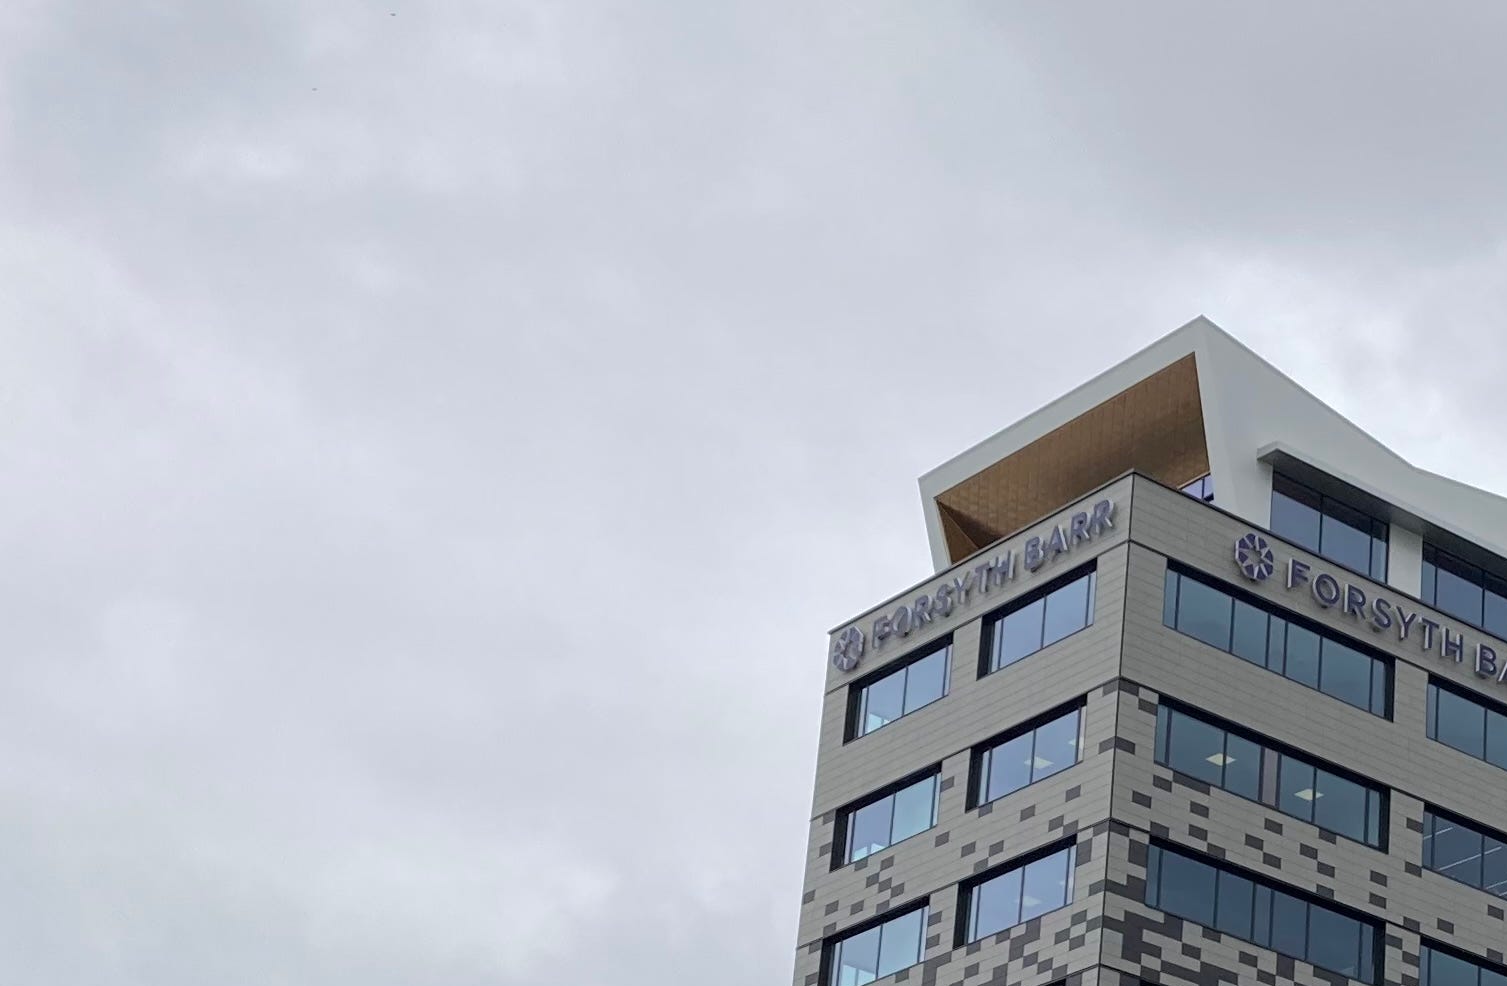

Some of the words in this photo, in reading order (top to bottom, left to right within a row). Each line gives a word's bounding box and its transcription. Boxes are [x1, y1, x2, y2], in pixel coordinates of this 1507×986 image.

[872, 549, 1015, 649] FORSYTH
[1023, 499, 1117, 573] BARR
[1287, 558, 1464, 663] FORSYTH
